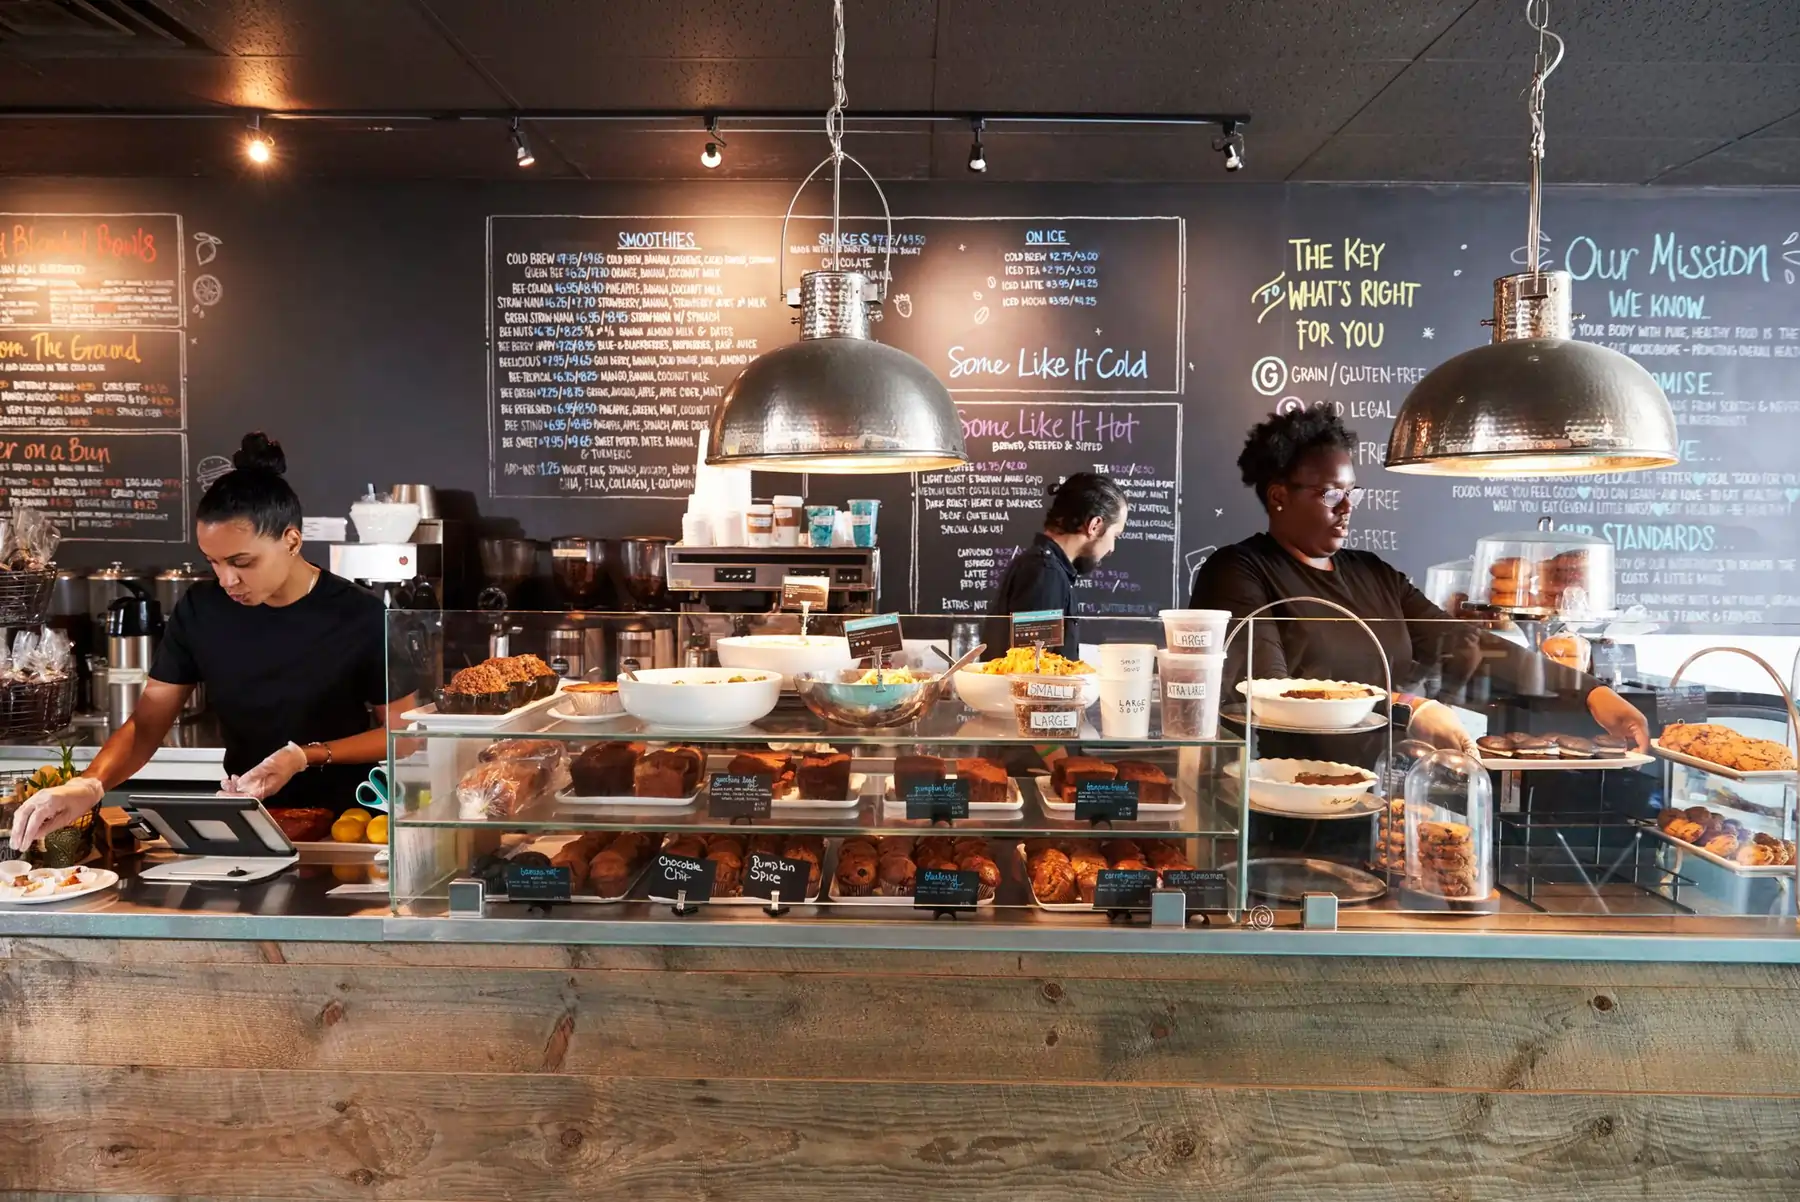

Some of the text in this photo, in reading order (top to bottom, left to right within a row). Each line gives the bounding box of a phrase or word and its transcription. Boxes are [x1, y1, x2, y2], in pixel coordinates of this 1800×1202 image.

[618, 231, 696, 248] SMOOTHIES
[1026, 230, 1066, 243] ON ICE
[97, 224, 157, 263] Bowls
[507, 253, 622, 265] COLD BREW COLD
[1004, 252, 1023, 262] COLD
[1024, 252, 1047, 262] BREW
[1288, 238, 1386, 271] THE KEY
[1565, 232, 1770, 282] Our Mission
[821, 257, 873, 269] CHCOLATE
[525, 266, 548, 278] QUEEN
[550, 267, 564, 278] BEE
[1005, 265, 1023, 276] ICED
[1024, 265, 1040, 276] TEA
[1001, 280, 1019, 290] ICED
[1021, 280, 1044, 290] LATTE
[1021, 296, 1047, 306] MOCHA
[1261, 285, 1280, 304] TO
[1288, 279, 1421, 311] WHAT'S RIGHT
[1609, 288, 1643, 318] WE
[505, 312, 528, 324] GREEN
[499, 326, 734, 338] BEE NUTS ALMOND MILK DATES
[1296, 318, 1384, 350] FOR YOU
[1579, 324, 1800, 340] YOUR BODY WITH HEALTHY FOOD IS THE
[31, 332, 142, 363] The Ground
[512, 341, 534, 352] BERRY
[948, 346, 1148, 380] Some Like It Cold
[657, 371, 689, 382] COCONUT
[691, 371, 710, 382] MILK
[514, 385, 725, 399] GREEN APPLE MINT
[680, 405, 710, 416] COCONUT
[1351, 400, 1397, 418] LEGAL
[504, 420, 689, 431] BEE APPLE
[957, 409, 1140, 444] Some Like It Hot
[502, 436, 614, 448] BEE SWEET SWEET
[1028, 440, 1103, 451] STEEPED SIPPED
[24, 437, 111, 464] on a Bun
[591, 449, 632, 460] TURMERIC
[537, 461, 560, 476] $1.25
[672, 463, 691, 475] HEMP
[1093, 464, 1109, 474] TEA
[922, 475, 943, 484] LIGHT
[1642, 471, 1652, 484] IS
[1452, 485, 1481, 498] FOODS
[1484, 485, 1509, 498] MAKE
[1511, 486, 1529, 498] YOU
[1531, 486, 1550, 498] FEEL
[1553, 486, 1577, 499] GOOD
[1592, 486, 1609, 499] YOU
[925, 498, 1043, 510] DARK HEART DARKNESS
[1493, 500, 1516, 512] WHAT
[1520, 500, 1538, 512] YOU
[1542, 501, 1558, 513] EAT
[1597, 501, 1624, 514] LITTLE
[966, 511, 1009, 521] GUATEMALA
[964, 569, 988, 578] LATTE
[1621, 572, 1693, 585] COSTS A LITTLE
[1174, 631, 1207, 647] LARGE
[1030, 684, 1072, 699] SMALL
[1119, 698, 1146, 707] LARGE
[1119, 706, 1145, 714] SOUP
[1034, 713, 1070, 728] LARGE
[658, 855, 796, 872] Chocolate Pumpkin
[750, 867, 781, 884] Spice
